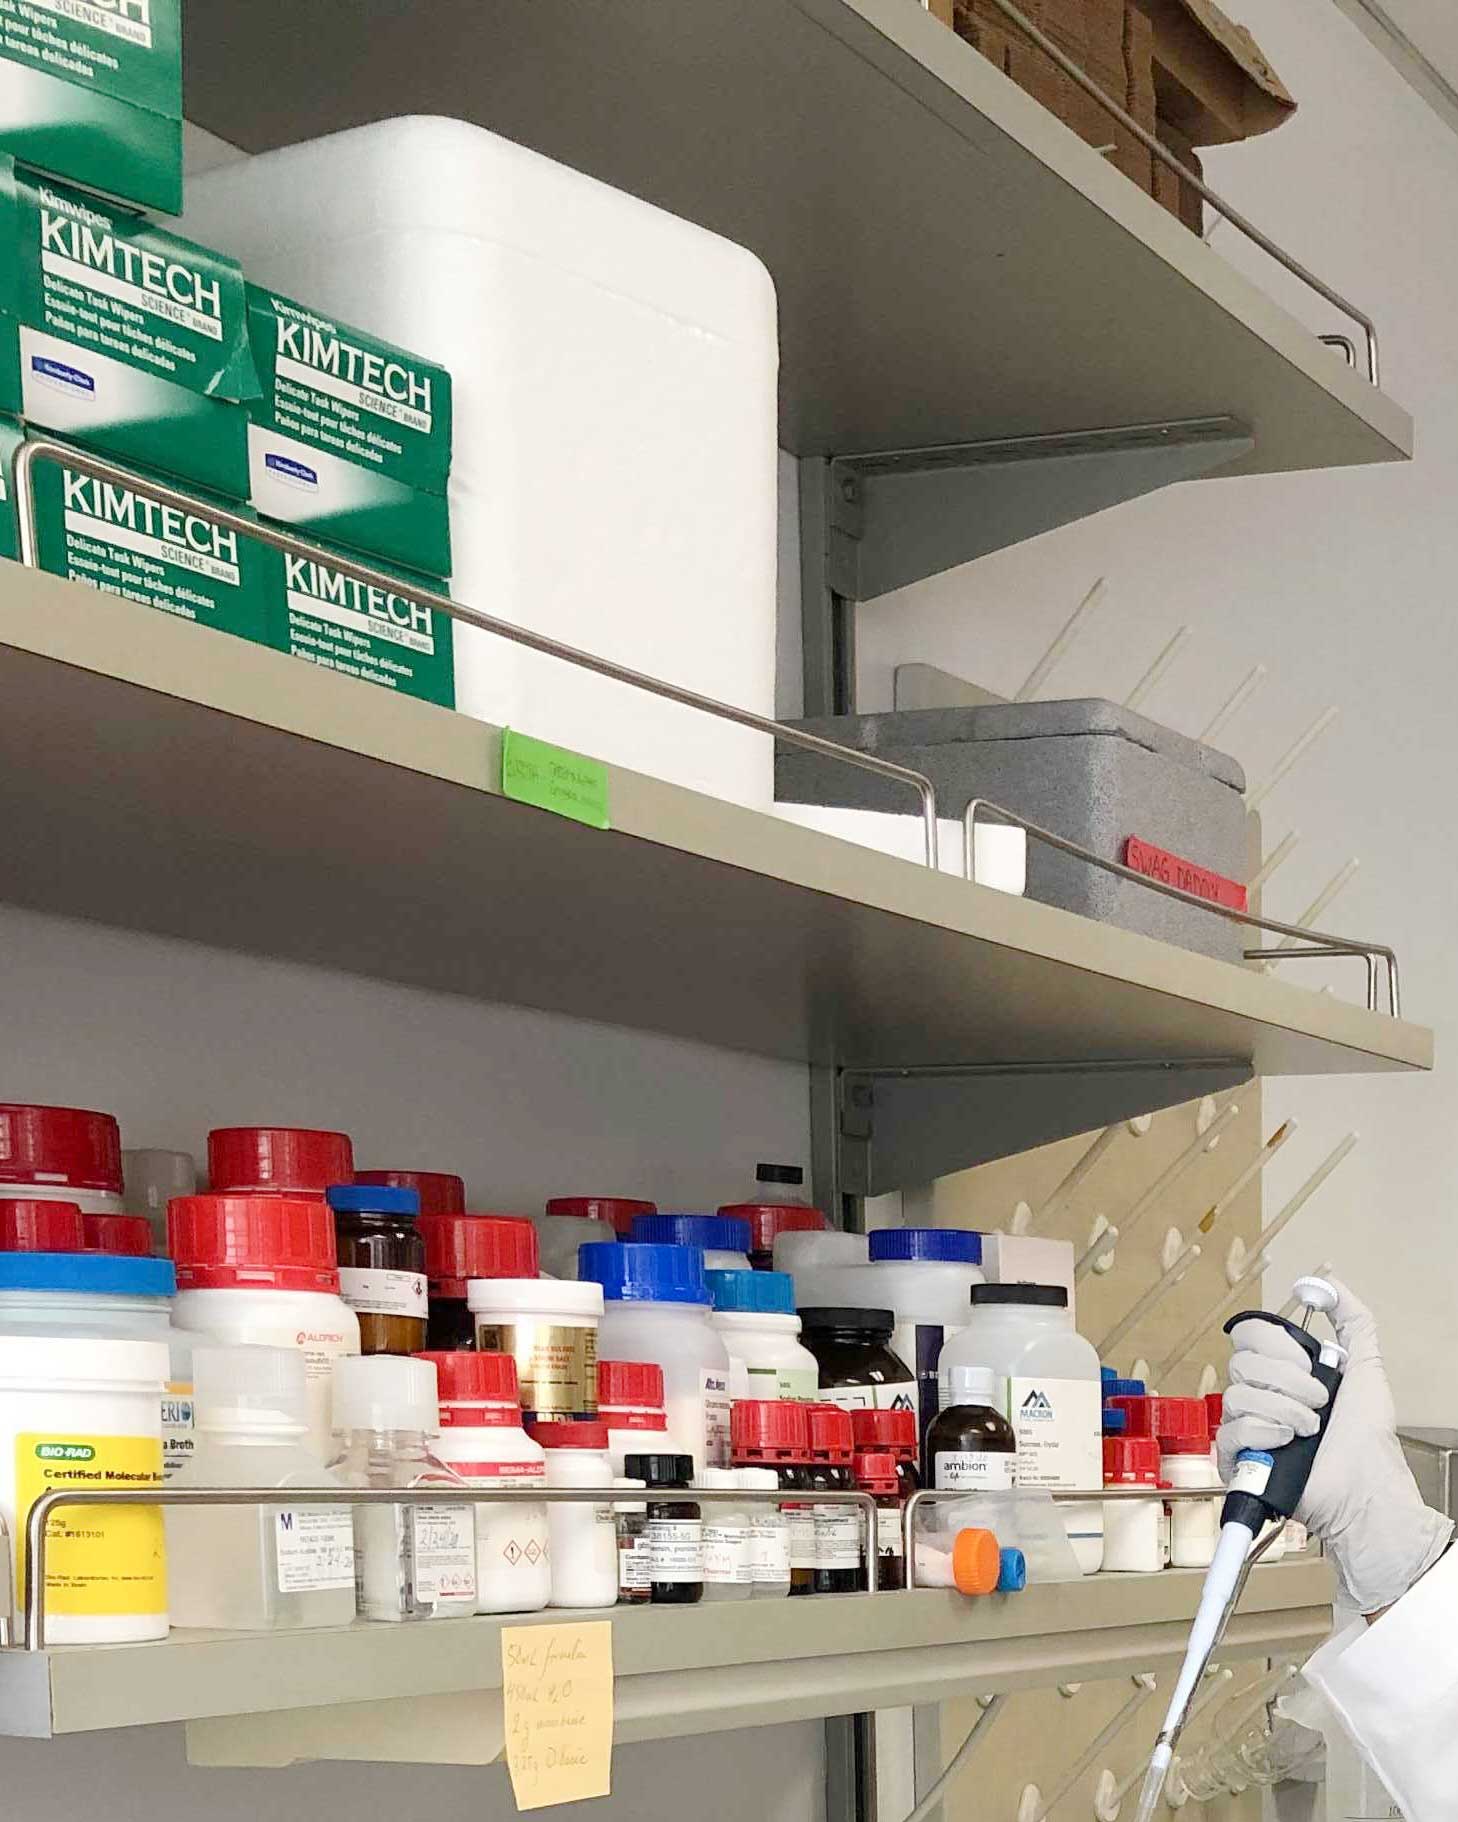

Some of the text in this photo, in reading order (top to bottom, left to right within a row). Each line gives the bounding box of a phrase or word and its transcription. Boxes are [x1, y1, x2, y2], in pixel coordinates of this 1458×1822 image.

[39, 186, 113, 231] Kimwipes
[41, 209, 221, 318] KIMTECH
[141, 292, 187, 323] SCIENCE
[276, 315, 432, 413] KIMTECH
[358, 390, 398, 418] SCIENCE
[62, 469, 239, 564] KIMTECH
[160, 545, 205, 571] SCIENCE
[284, 552, 433, 635] KIMTECH
[367, 619, 404, 643] SCIENCE
[170, 1438, 194, 1450] Broth
[43, 1468, 102, 1480] Certified
[105, 1470, 151, 1481] Molecular
[943, 1459, 987, 1472] ambion
